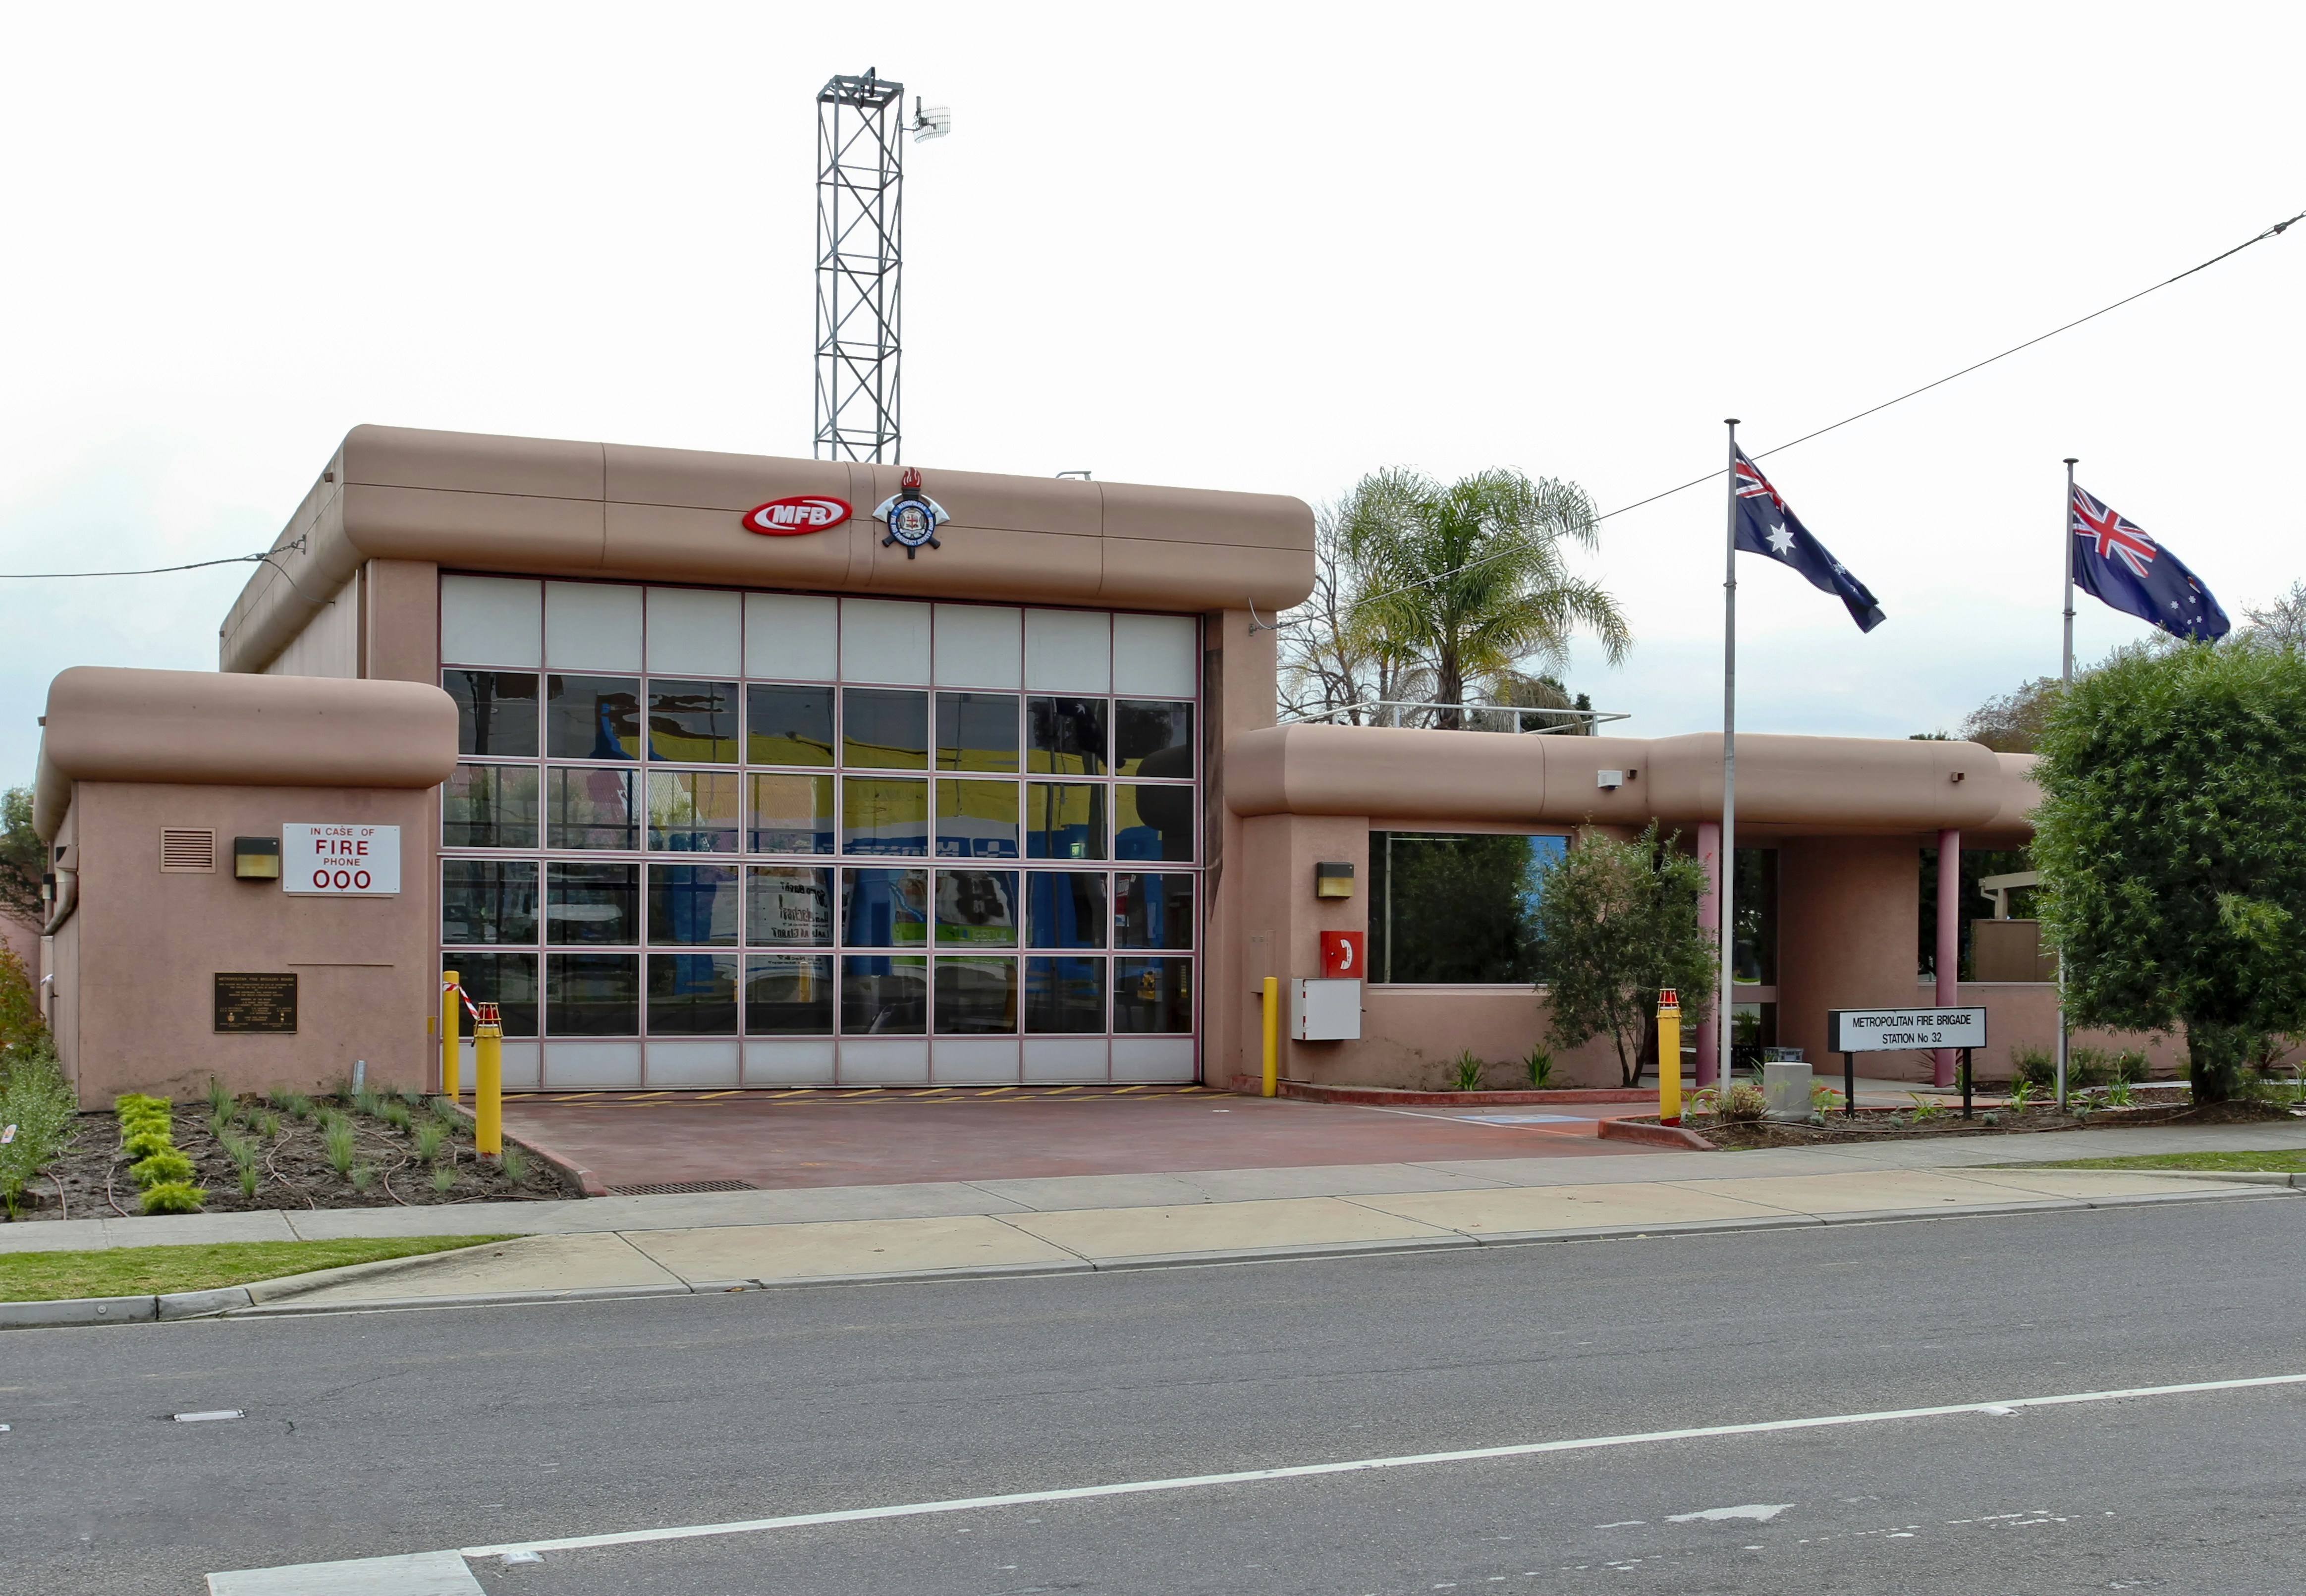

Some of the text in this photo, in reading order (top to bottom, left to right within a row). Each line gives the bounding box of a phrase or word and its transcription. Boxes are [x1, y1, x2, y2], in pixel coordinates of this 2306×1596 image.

[771, 504, 826, 525] MFB
[326, 827, 353, 836] CASE
[316, 839, 369, 855] FIRE
[324, 858, 361, 866] PHONE
[1853, 1015, 1971, 1027] METROPOLITAN FIRE BRIGADE
[1882, 1032, 1942, 1044] STATION No 32
